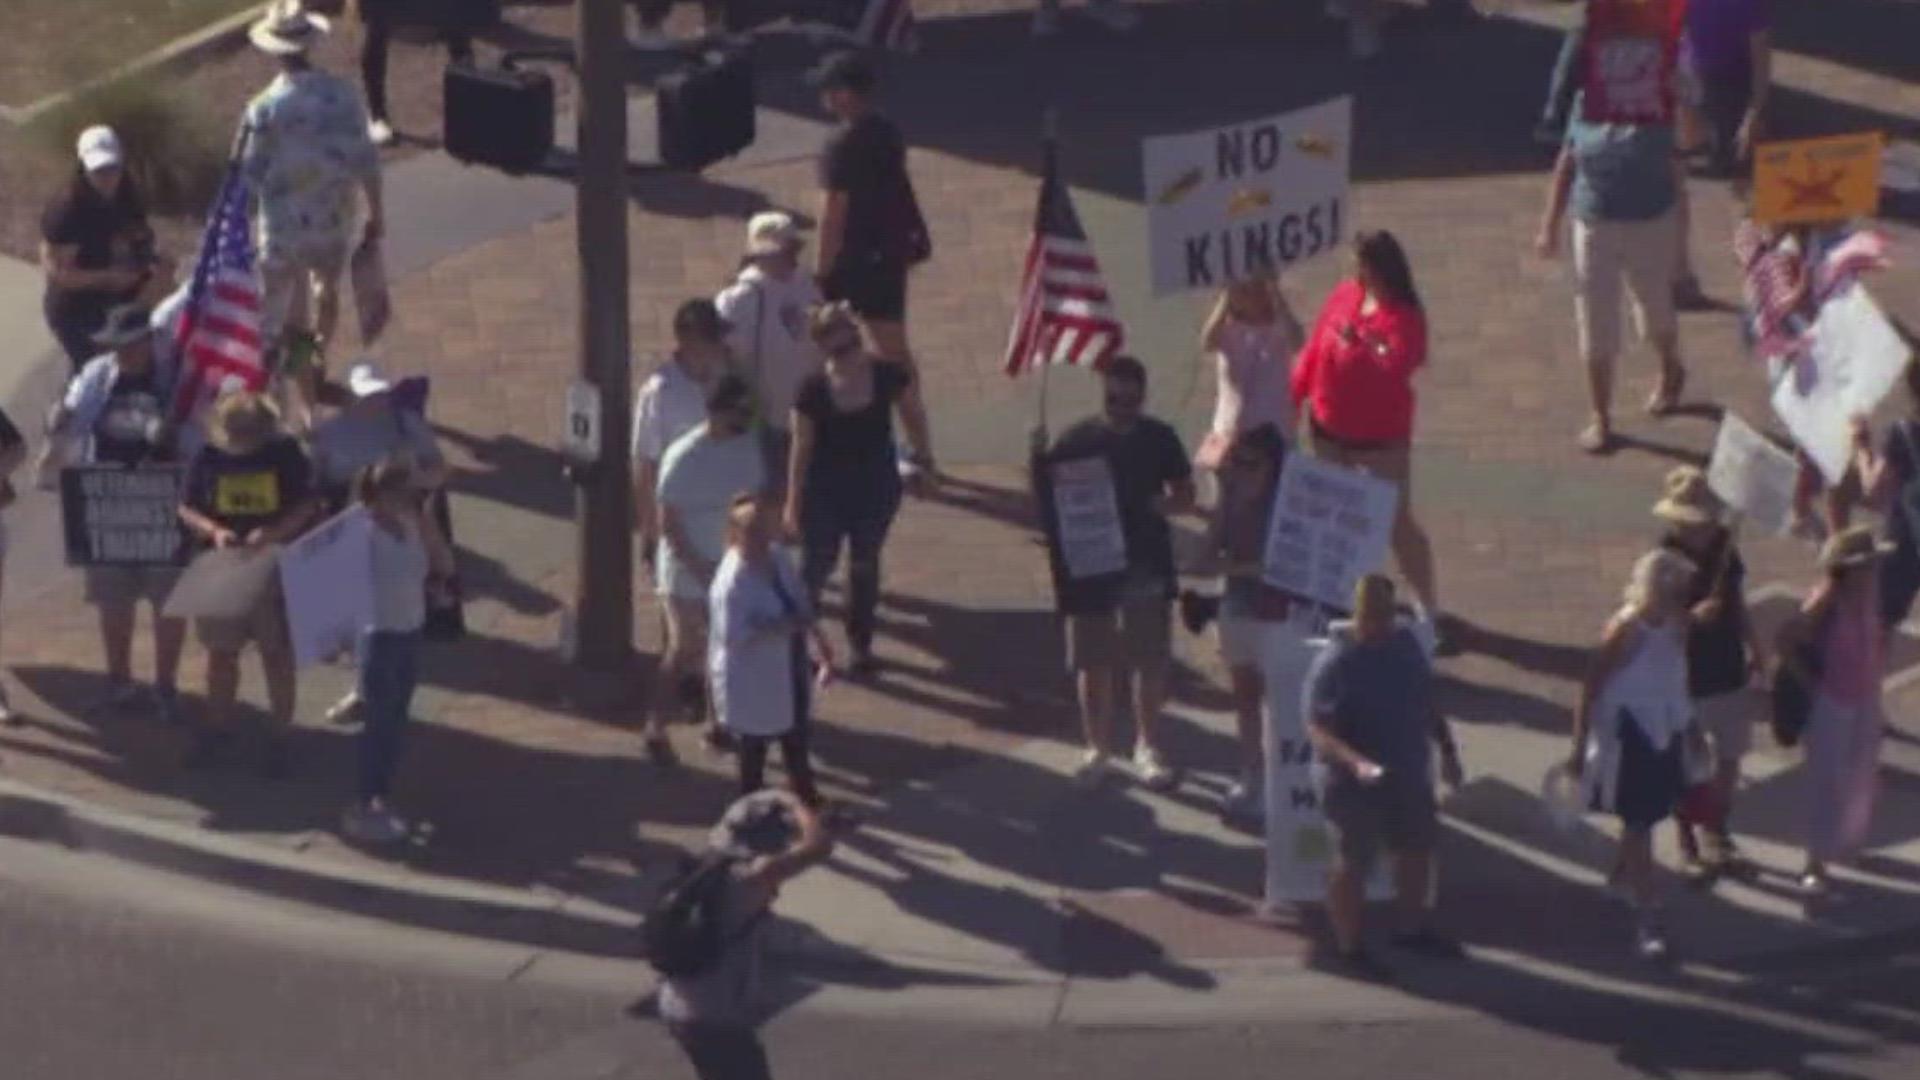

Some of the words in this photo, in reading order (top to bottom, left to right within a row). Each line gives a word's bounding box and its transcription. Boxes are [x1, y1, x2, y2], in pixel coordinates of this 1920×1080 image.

[1217, 125, 1279, 178] NO
[1186, 198, 1339, 285] KINGS!
[91, 530, 181, 560] TRUMP
